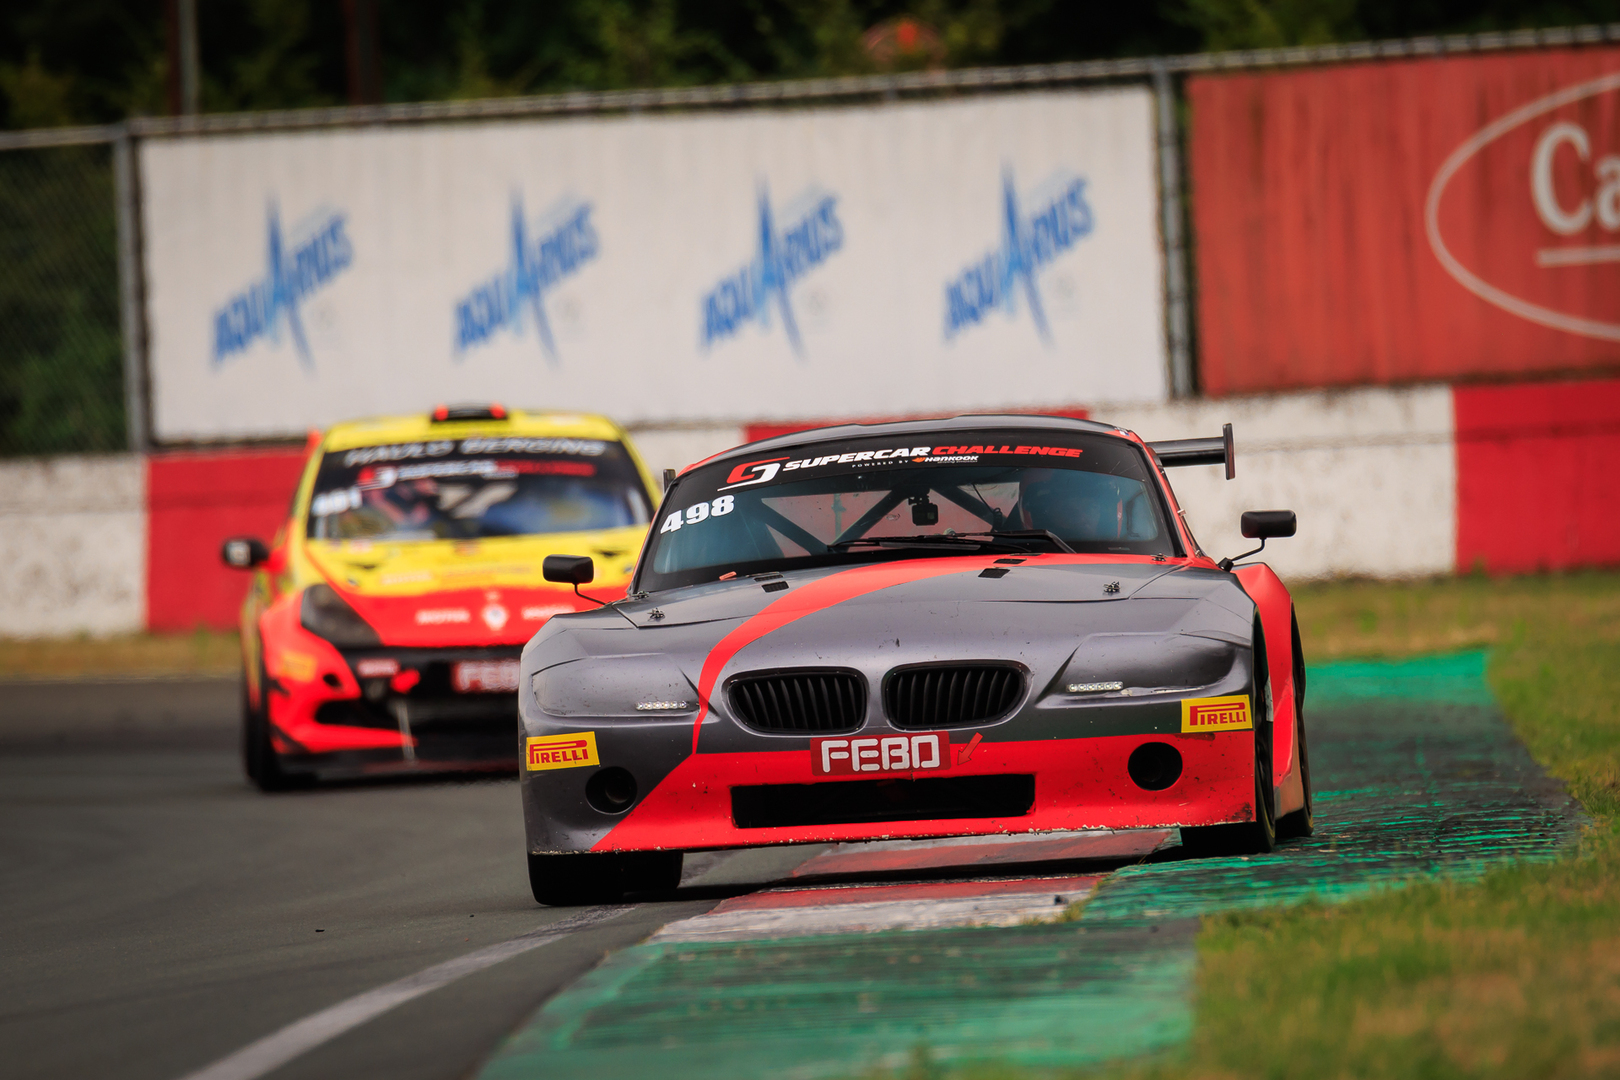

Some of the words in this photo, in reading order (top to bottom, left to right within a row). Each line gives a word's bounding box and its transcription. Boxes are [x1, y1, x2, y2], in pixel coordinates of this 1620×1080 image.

[783, 446, 931, 471] SUPERCAR
[932, 445, 1083, 458] CHALLENGE
[851, 460, 893, 468] POWERED
[660, 495, 735, 534] 498
[1189, 702, 1246, 726] PIRELLI
[529, 740, 588, 764] PIRELLI
[821, 734, 940, 773] FEBO
